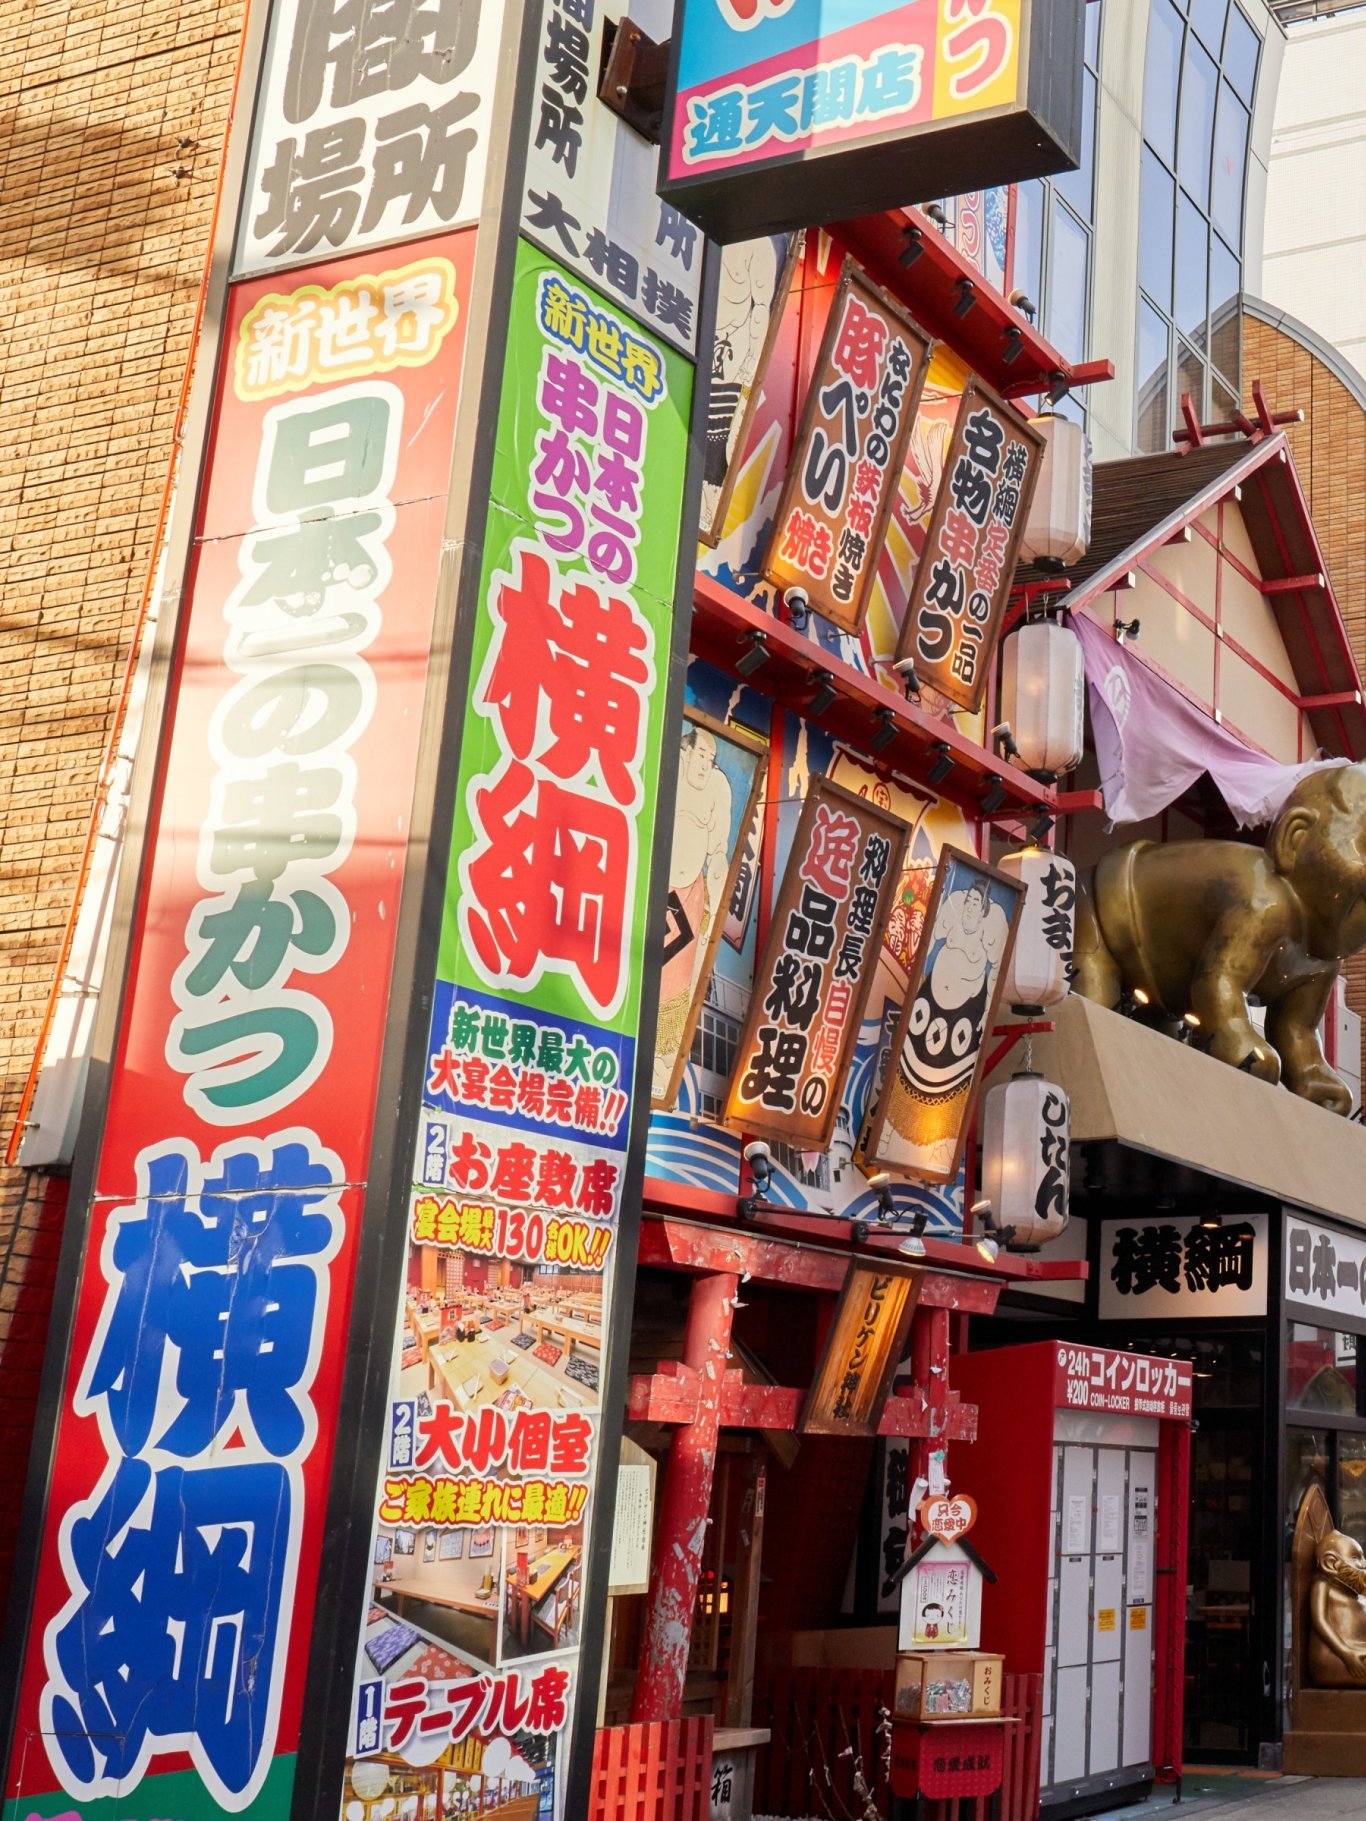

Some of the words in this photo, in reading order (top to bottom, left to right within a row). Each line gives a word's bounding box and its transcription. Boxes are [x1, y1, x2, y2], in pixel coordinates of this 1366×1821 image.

[688, 47, 919, 160] 通天閣店
[253, 91, 481, 257] 場所
[524, 189, 695, 339] 大相撲
[245, 271, 445, 387] 新世界
[544, 283, 661, 398] 新世界
[533, 354, 599, 553] 串かつ
[780, 298, 888, 578] 豚ぺい焼き
[832, 338, 912, 602] なにわの鉄板焼き
[589, 393, 645, 584] 日本一の
[918, 410, 1004, 661] 名物串かつ
[952, 442, 1028, 684] 横綱定番の一品
[178, 392, 392, 1111] 日本一の串かつ
[468, 550, 649, 1006] 横綱
[741, 805, 860, 1112] 逸品料理
[802, 834, 890, 1115] 料理長自慢の
[430, 1050, 626, 1133] 大宴会場完備!!
[452, 1006, 616, 1085] 新世界最大の
[427, 1125, 445, 1182] 2階
[450, 1132, 618, 1216] お座敷席
[1112, 1223, 1256, 1294] 横綱
[834, 1275, 893, 1420] ビリケン神社
[1067, 1350, 1090, 1377] 24h
[1091, 1353, 1191, 1396] コインロッカー
[1067, 1379, 1089, 1406] ¥200
[1090, 1393, 1131, 1410] COIN-LOCKER
[51, 1143, 333, 1795] 横綱
[393, 1403, 413, 1466] 2階
[415, 1404, 593, 1474] 大小個室
[380, 1477, 588, 1526] ご家族連れに最適!!
[931, 1517, 967, 1533] 恋愛中
[937, 1503, 963, 1517] 只今
[946, 1567, 959, 1636] 恋みくじ
[358, 1684, 382, 1752] 1階
[384, 1666, 568, 1747] テーブル席
[983, 1666, 993, 1706] おみくじ
[710, 1764, 734, 1807] 箱
